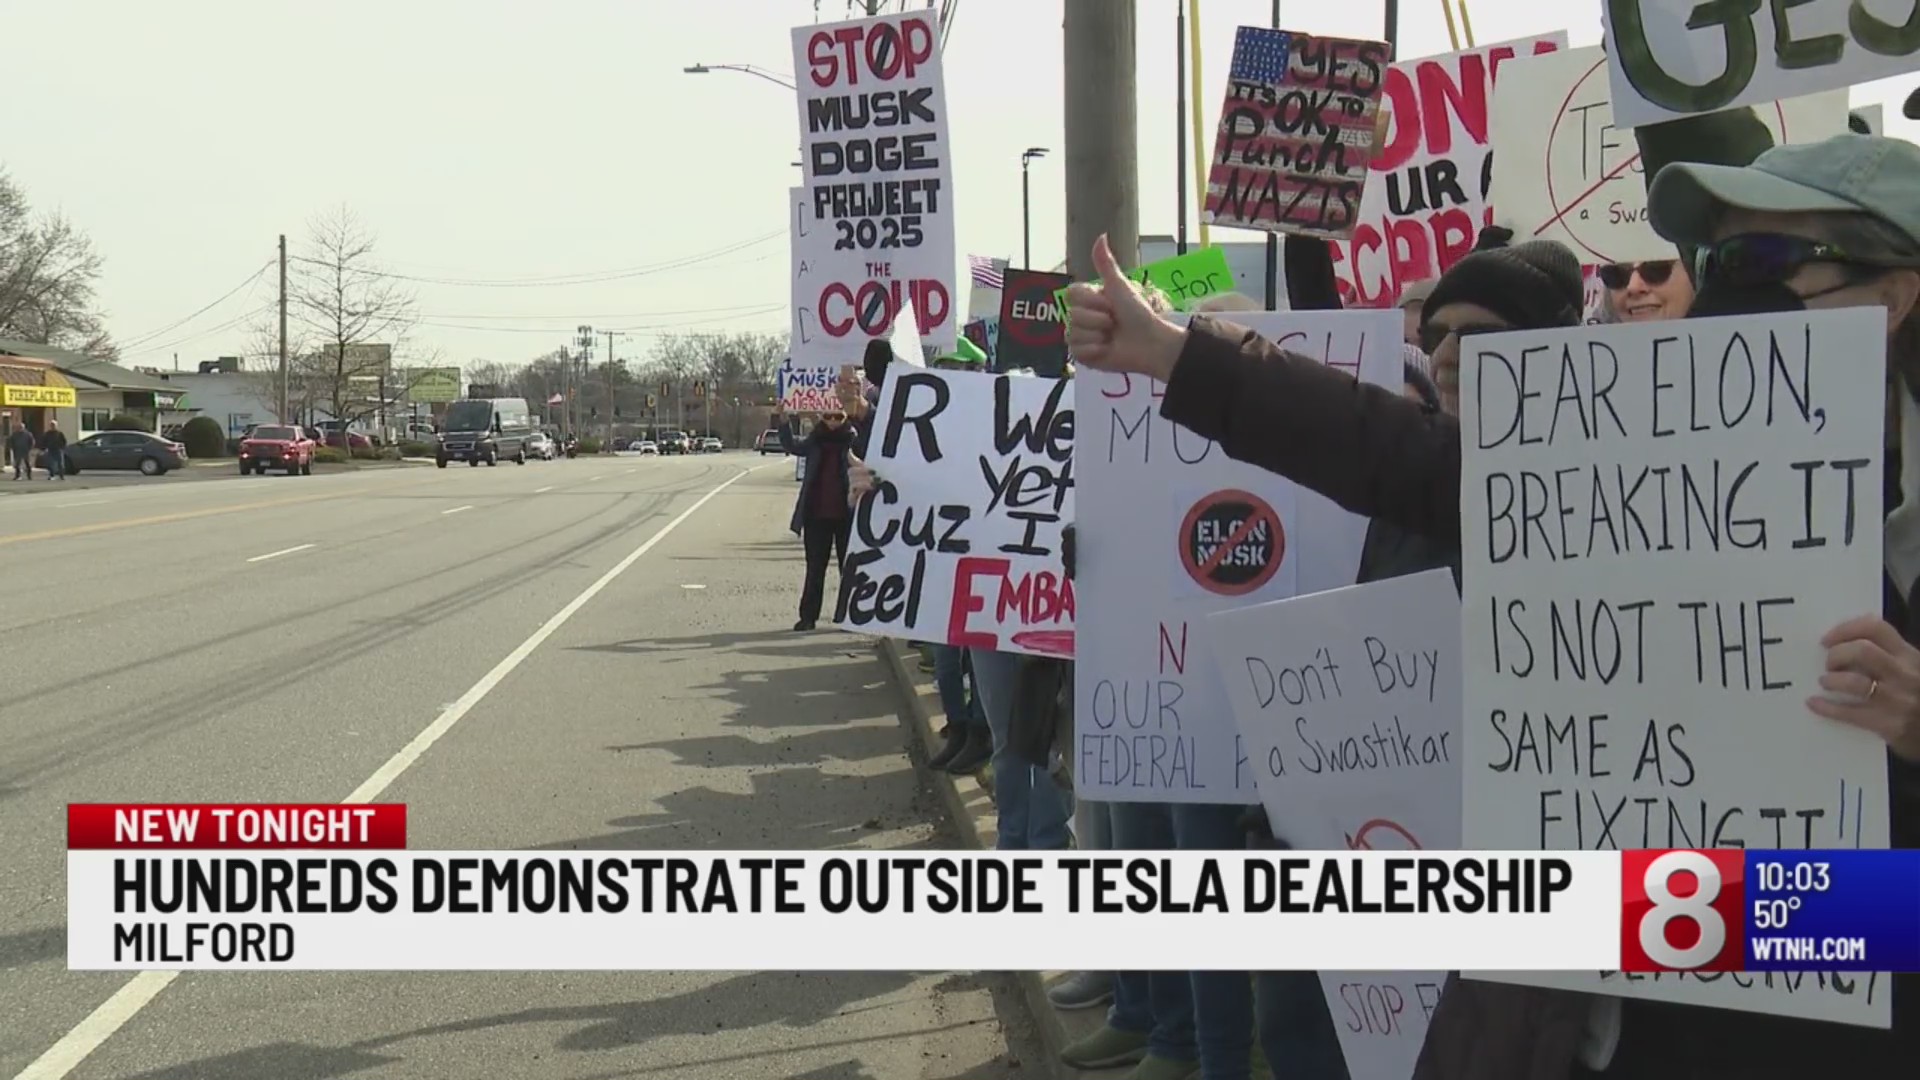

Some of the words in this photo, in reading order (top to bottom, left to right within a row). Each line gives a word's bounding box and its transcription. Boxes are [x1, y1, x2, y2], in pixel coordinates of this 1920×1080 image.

[807, 18, 933, 88] STOP
[1289, 37, 1387, 97] YES
[807, 87, 936, 133] MUSK
[1273, 90, 1333, 136] OK
[1337, 96, 1366, 118] TO
[811, 132, 940, 177] DOGE
[1221, 106, 1349, 176] Punch
[813, 178, 941, 219] PROJECT
[1214, 167, 1360, 232] NAZIS
[1385, 159, 1469, 215] UR
[834, 216, 924, 250] 2025
[865, 262, 891, 277] THE
[1170, 270, 1220, 300] for
[793, 388, 829, 399] NOT
[881, 372, 951, 463] R
[993, 375, 1075, 462] We
[1477, 341, 1627, 449] DEAR
[1109, 404, 1213, 464] MU
[856, 480, 971, 554] Cuz
[997, 511, 1061, 556] I
[1486, 458, 1767, 564] BREAKING
[1789, 457, 1871, 550] IT
[947, 556, 1075, 651] EMBA
[1490, 596, 1535, 678] IS
[1550, 598, 1656, 685] NOT
[1677, 597, 1795, 691] THE
[1091, 679, 1185, 732] OUR
[1246, 647, 1342, 708] Don't
[1081, 733, 1206, 789] FEDERAL
[1268, 745, 1288, 778] a
[1295, 715, 1451, 775] Swastikar
[1488, 708, 1612, 779] SAME
[1632, 718, 1696, 788] AS
[1340, 983, 1404, 1036] STOP
